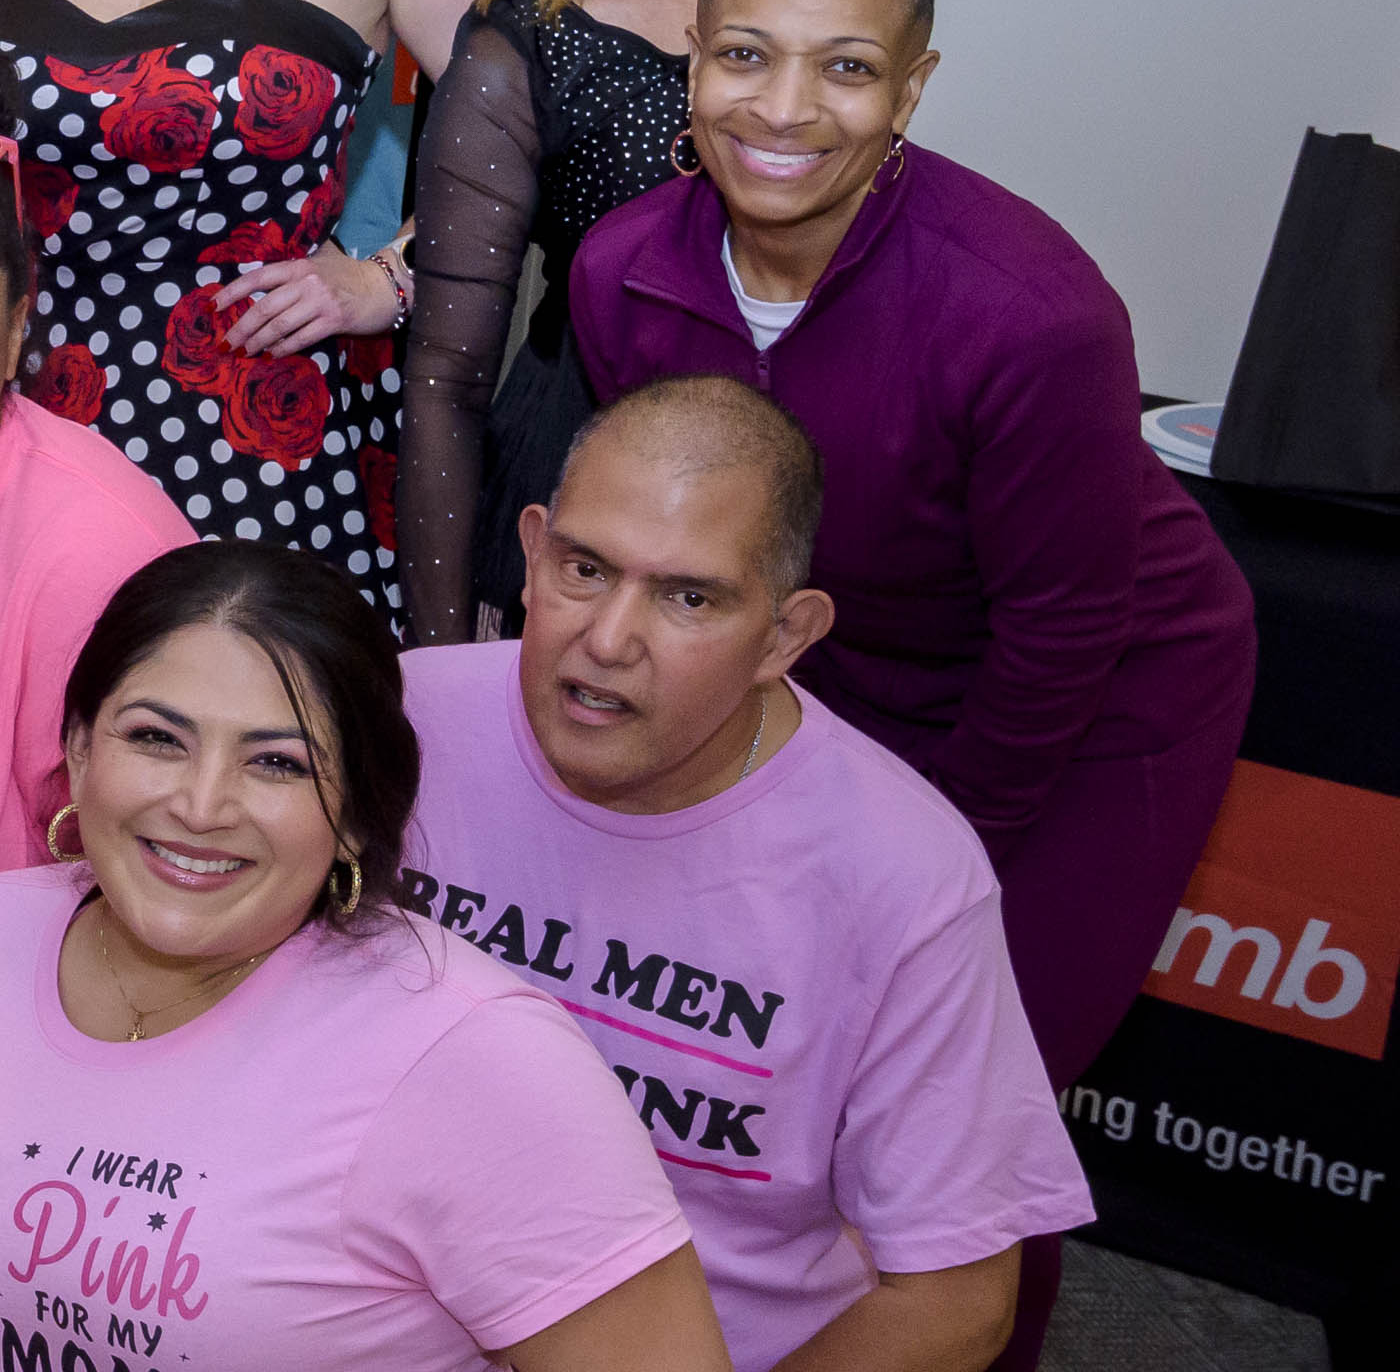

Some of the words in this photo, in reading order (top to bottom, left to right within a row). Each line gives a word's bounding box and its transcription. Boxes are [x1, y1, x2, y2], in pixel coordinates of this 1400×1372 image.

[400, 867, 574, 982] REAL
[591, 938, 785, 1049] MEN
[1151, 906, 1367, 1019] mb
[66, 1146, 85, 1176] I
[91, 1149, 183, 1200] WEAR
[1154, 1101, 1385, 1203] together
[7, 1179, 209, 1321] Pink
[35, 1290, 93, 1342] FOR
[106, 1313, 163, 1358] MY
